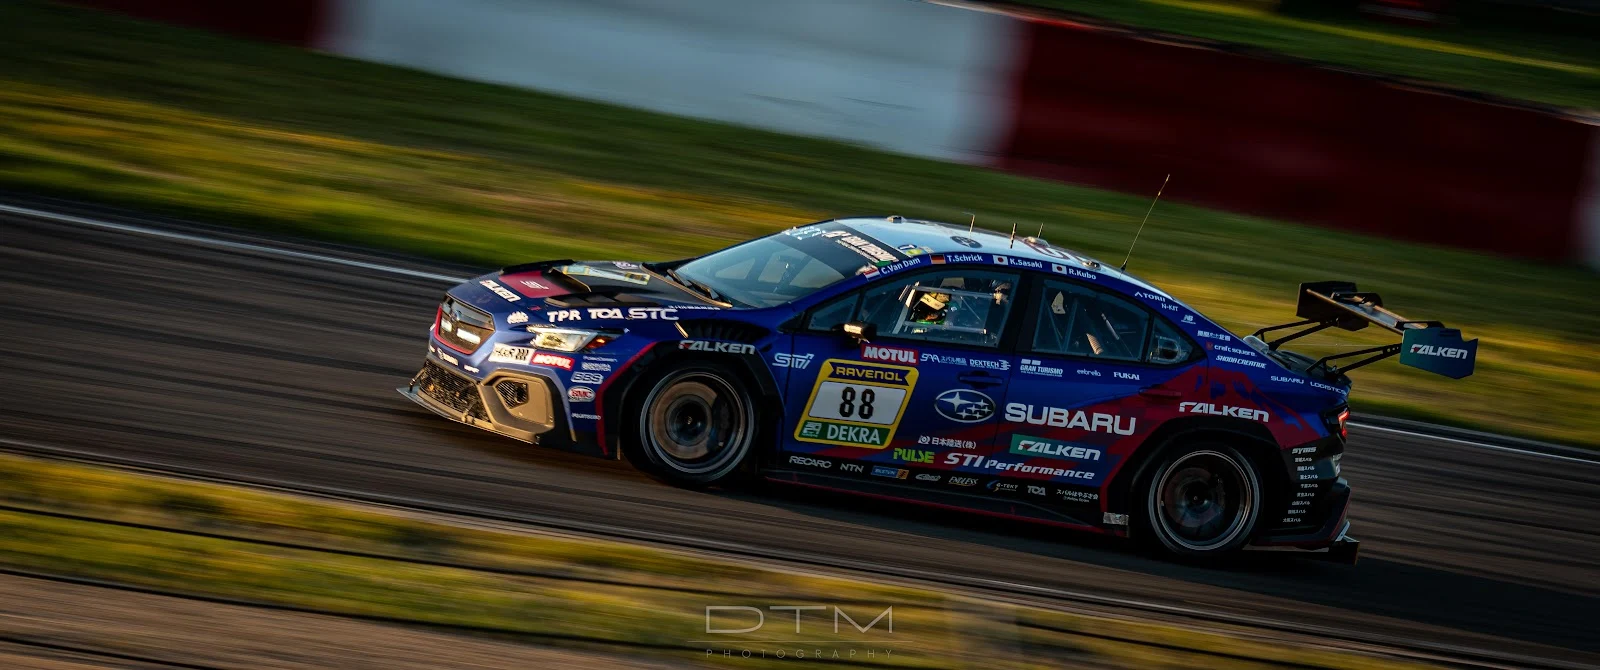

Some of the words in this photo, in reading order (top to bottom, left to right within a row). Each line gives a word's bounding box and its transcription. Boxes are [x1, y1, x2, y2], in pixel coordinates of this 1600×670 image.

[946, 254, 984, 262] T.Schrick
[1009, 258, 1043, 269] K.Sasaki
[881, 262, 903, 275] C.Van
[903, 258, 921, 268] Dam
[1068, 268, 1097, 280] R.Kubo
[547, 309, 582, 323] TPR
[587, 308, 623, 320] TOA
[627, 307, 679, 321] STC
[678, 340, 756, 355] FALKEN
[863, 346, 917, 363] MOTUL
[1409, 344, 1468, 360] FALKEN
[532, 353, 572, 369] MOTUL
[969, 359, 999, 368] DEXTECH
[835, 366, 903, 382] RAVENOL
[1020, 364, 1037, 372] GRAN
[1037, 366, 1064, 375] TURISMO
[1113, 371, 1140, 381] FUKAI
[1270, 375, 1305, 385] SUBARU
[1309, 381, 1347, 397] LOGISTICS
[838, 387, 875, 419] 88
[1004, 402, 1137, 436] SUBARU
[1178, 401, 1270, 423] FALKEN
[826, 424, 881, 445] DEKRA
[893, 447, 935, 464] PULSE
[1017, 440, 1101, 461] FALKEN
[789, 455, 832, 469] RECARO
[839, 462, 865, 473] NTN
[944, 452, 985, 468] STI
[985, 459, 1096, 480] Performance
[1027, 485, 1046, 496] TOA
